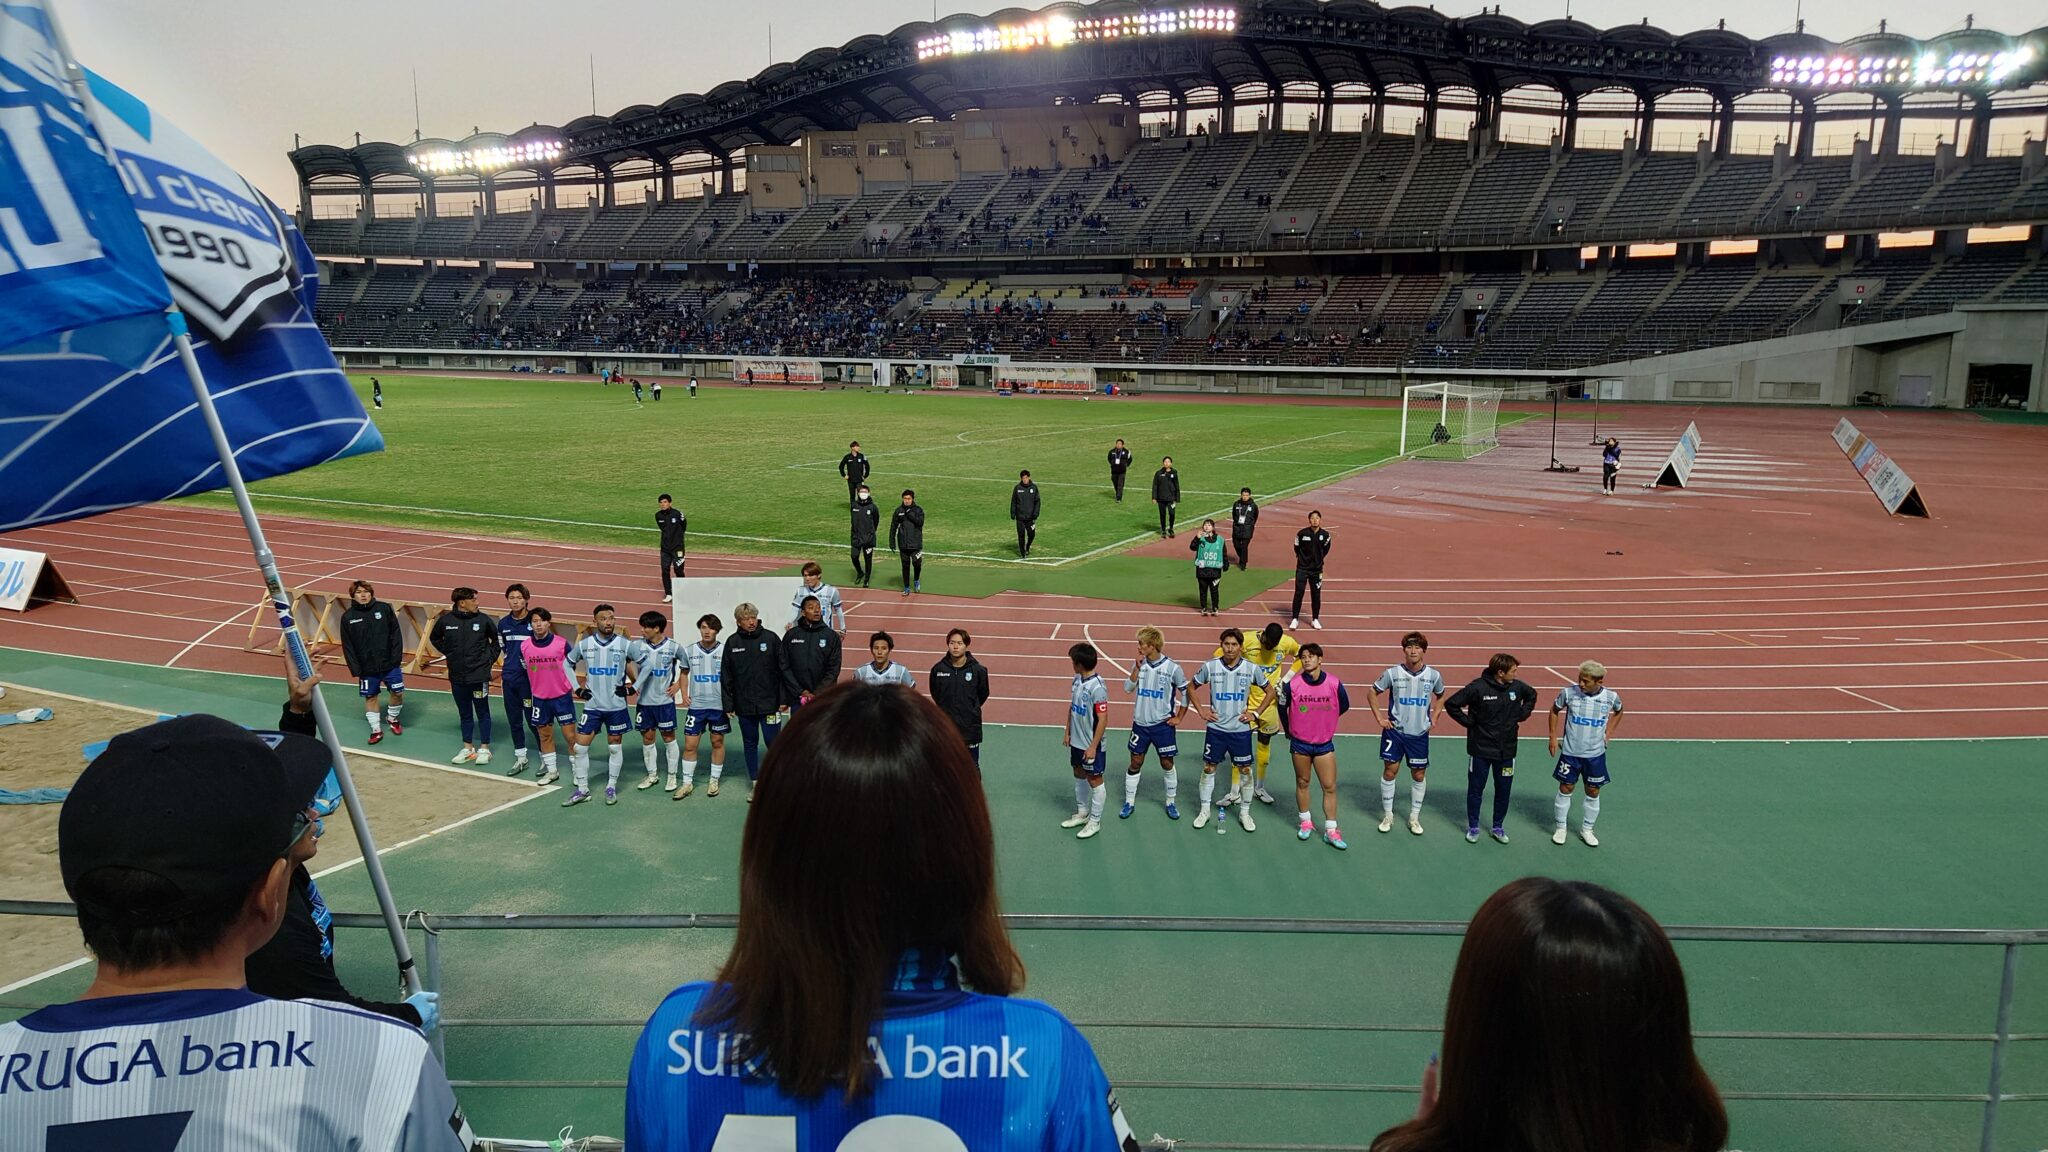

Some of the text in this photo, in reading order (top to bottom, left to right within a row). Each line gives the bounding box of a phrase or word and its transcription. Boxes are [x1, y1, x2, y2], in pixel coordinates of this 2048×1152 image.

[157, 174, 272, 238] claro
[589, 664, 618, 676] usui
[360, 680, 369, 690] 11
[1137, 687, 1165, 699] usui
[1216, 689, 1245, 701] usui
[1400, 695, 1428, 706] usui
[1572, 715, 1606, 728] usui
[1384, 740, 1393, 752] 7
[667, 1029, 1030, 1080] SURA bank
[0, 1031, 316, 1094] RUGA bank
